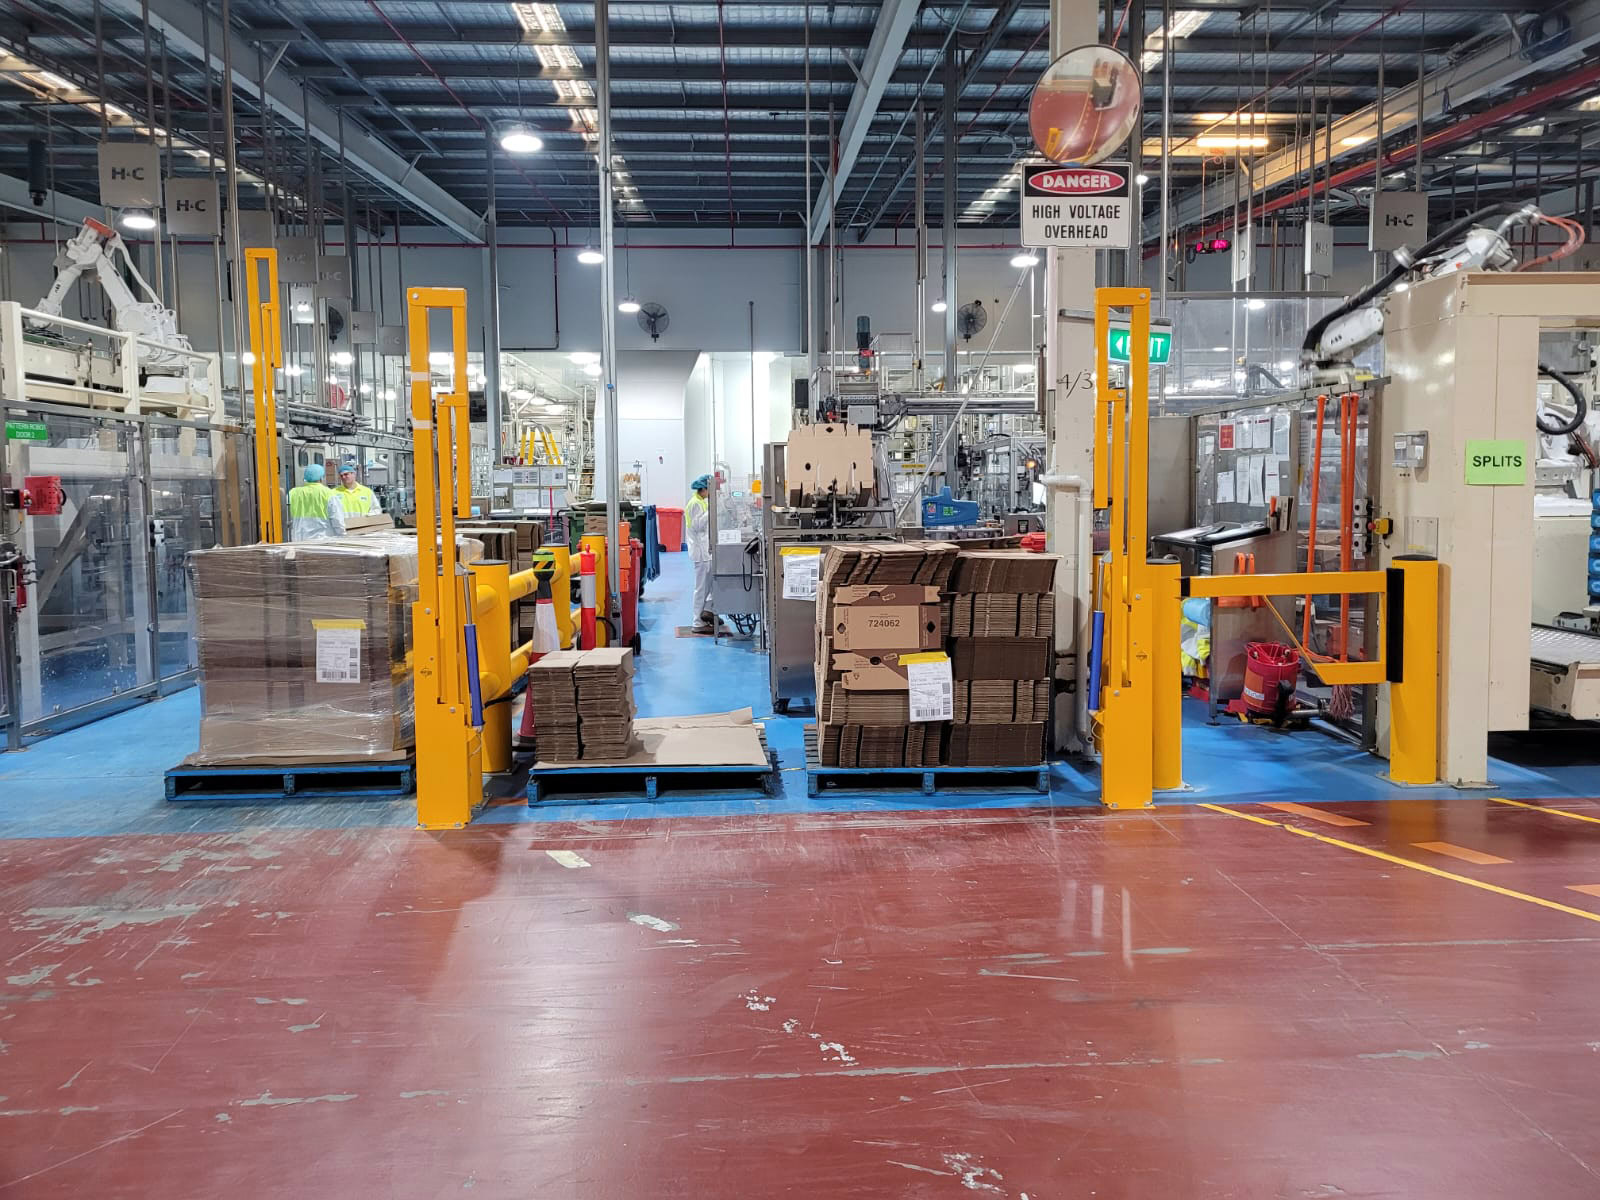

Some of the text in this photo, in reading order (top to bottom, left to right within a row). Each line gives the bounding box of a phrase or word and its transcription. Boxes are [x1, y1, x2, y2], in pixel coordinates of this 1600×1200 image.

[1042, 175, 1110, 188] DANGER
[1032, 205, 1120, 219] HIGH VOLTAGE
[1044, 225, 1108, 239] OVERHEAD
[1126, 335, 1165, 358] IT
[1472, 455, 1522, 467] SPLITS
